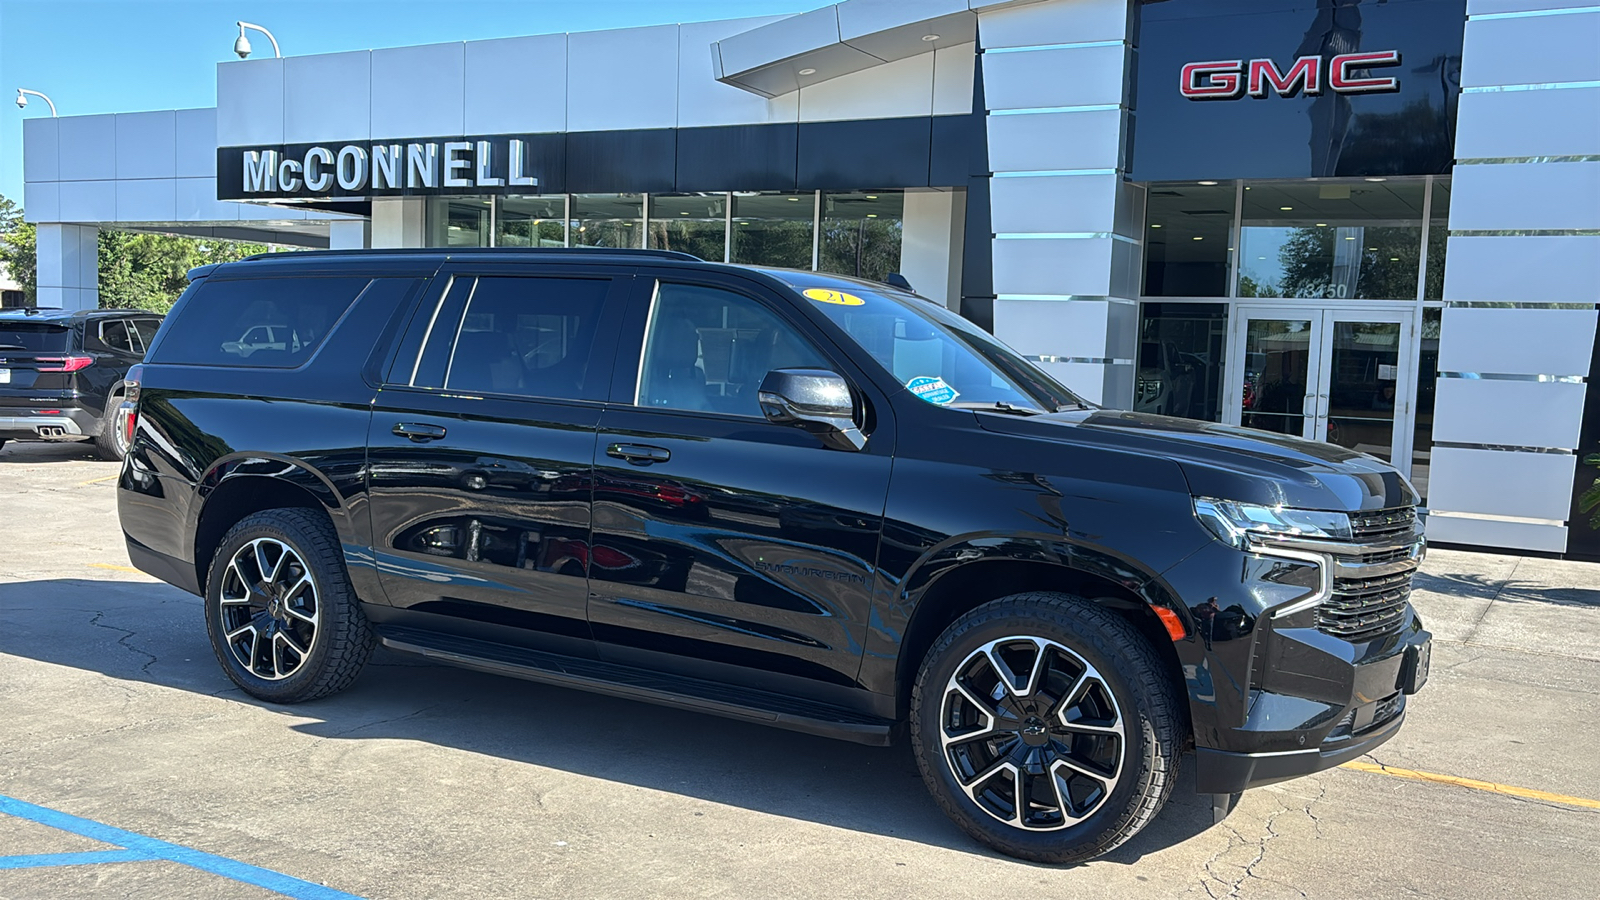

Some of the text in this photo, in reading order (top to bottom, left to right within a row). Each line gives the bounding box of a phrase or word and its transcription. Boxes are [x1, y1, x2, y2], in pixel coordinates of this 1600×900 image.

[1179, 49, 1400, 98] GMC
[823, 290, 845, 303] 21
[753, 561, 866, 584] SUBURBAN
